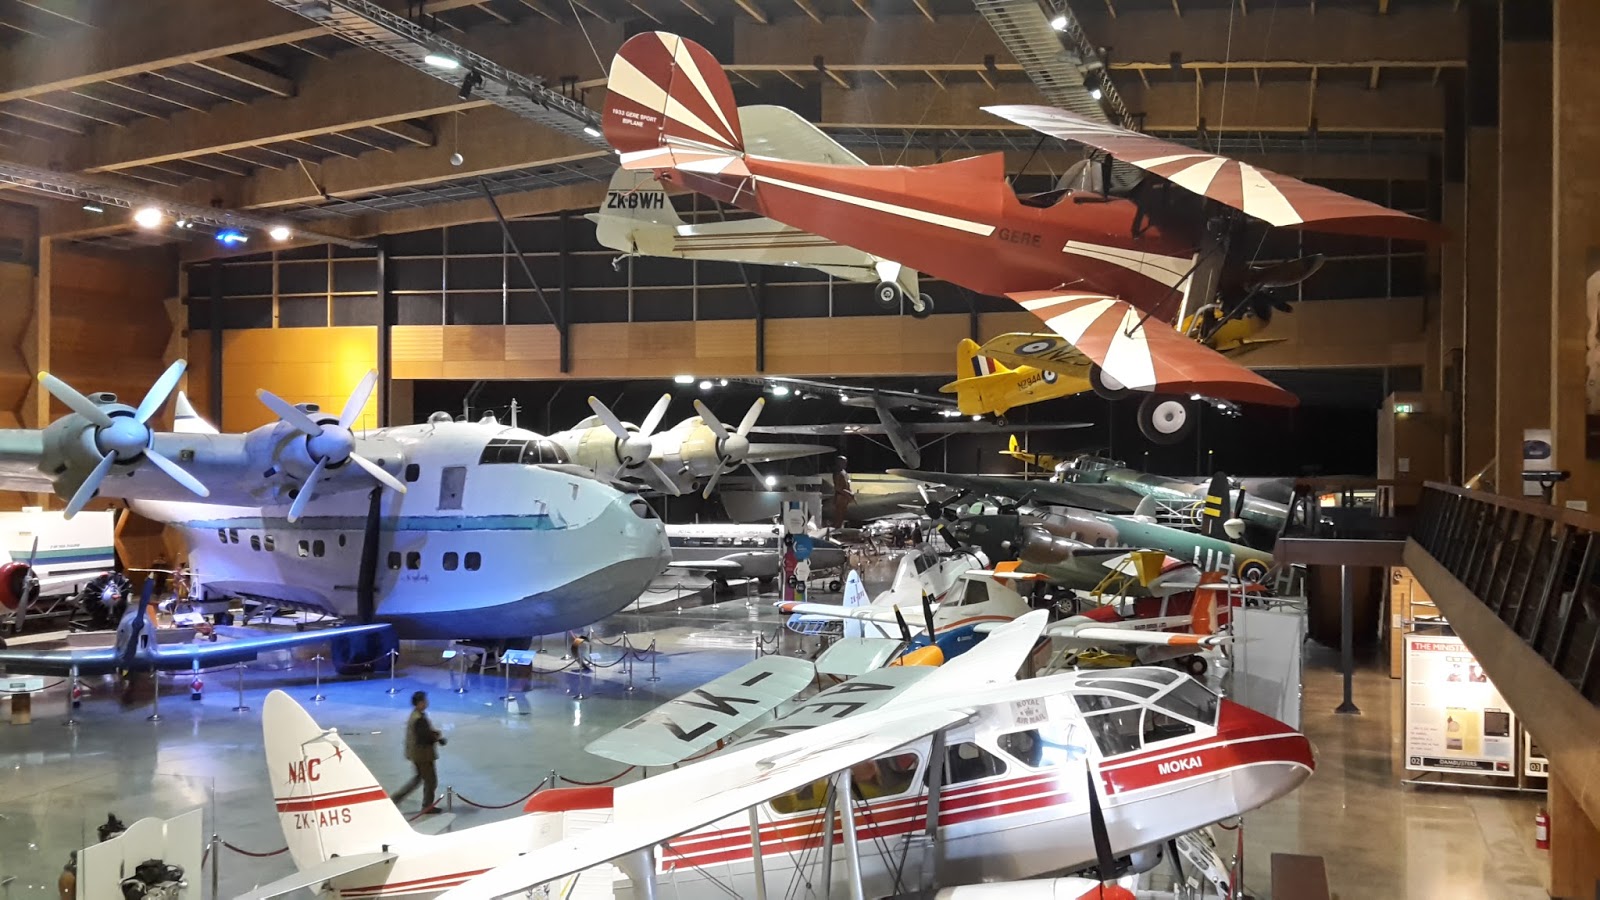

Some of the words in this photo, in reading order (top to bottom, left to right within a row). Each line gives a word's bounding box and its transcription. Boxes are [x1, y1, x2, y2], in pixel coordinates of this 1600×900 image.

[622, 118, 644, 127] BIPLANE
[640, 114, 657, 123] SPORT
[607, 192, 665, 209] ZK-BWH
[999, 228, 1042, 248] GERE
[1414, 643, 1432, 651] THE
[1432, 643, 1468, 652] MINISTR
[1016, 699, 1041, 709] ROYAL
[1016, 717, 1029, 725] AIR
[1029, 713, 1046, 725] MAIL
[1157, 755, 1203, 776] MOKAI
[1411, 757, 1420, 765] 02
[1439, 759, 1478, 767] DAMBUSTERS
[288, 758, 321, 784] NAC
[294, 807, 352, 830] ZK-AHS
